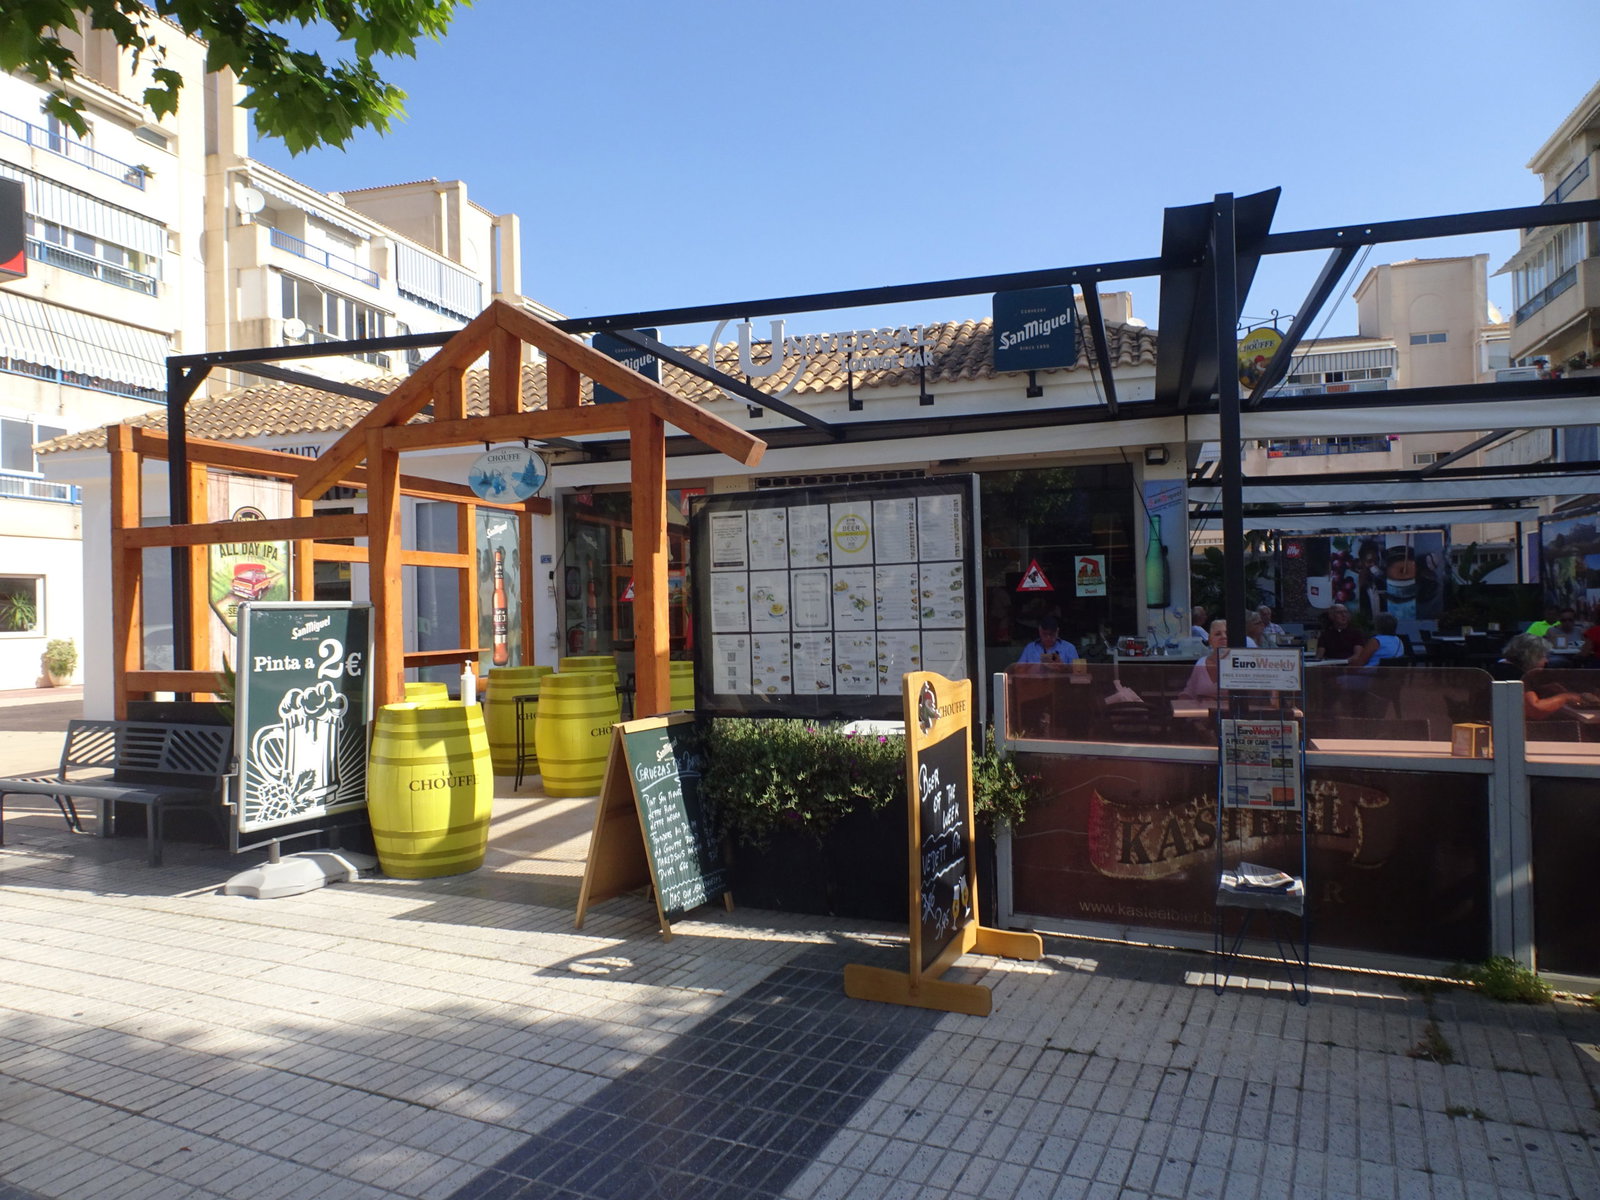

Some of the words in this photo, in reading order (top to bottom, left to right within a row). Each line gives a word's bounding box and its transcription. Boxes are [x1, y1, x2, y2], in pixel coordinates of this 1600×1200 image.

[998, 308, 1071, 350] SanMiguel
[841, 354, 899, 373] LOUNGE
[904, 351, 935, 368] BAR
[487, 453, 521, 462] CHOUFFE
[219, 544, 239, 558] ALL
[242, 542, 260, 556] DAY
[263, 544, 278, 561] IPA
[253, 656, 301, 673] Pinta
[304, 657, 315, 669] a
[1232, 657, 1296, 672] EuroWeekly
[635, 762, 671, 783] CERVEZAS
[918, 763, 940, 803] BEER
[409, 774, 480, 793] CHOUFFE
[946, 783, 957, 804] THE
[942, 802, 961, 830] WEEK
